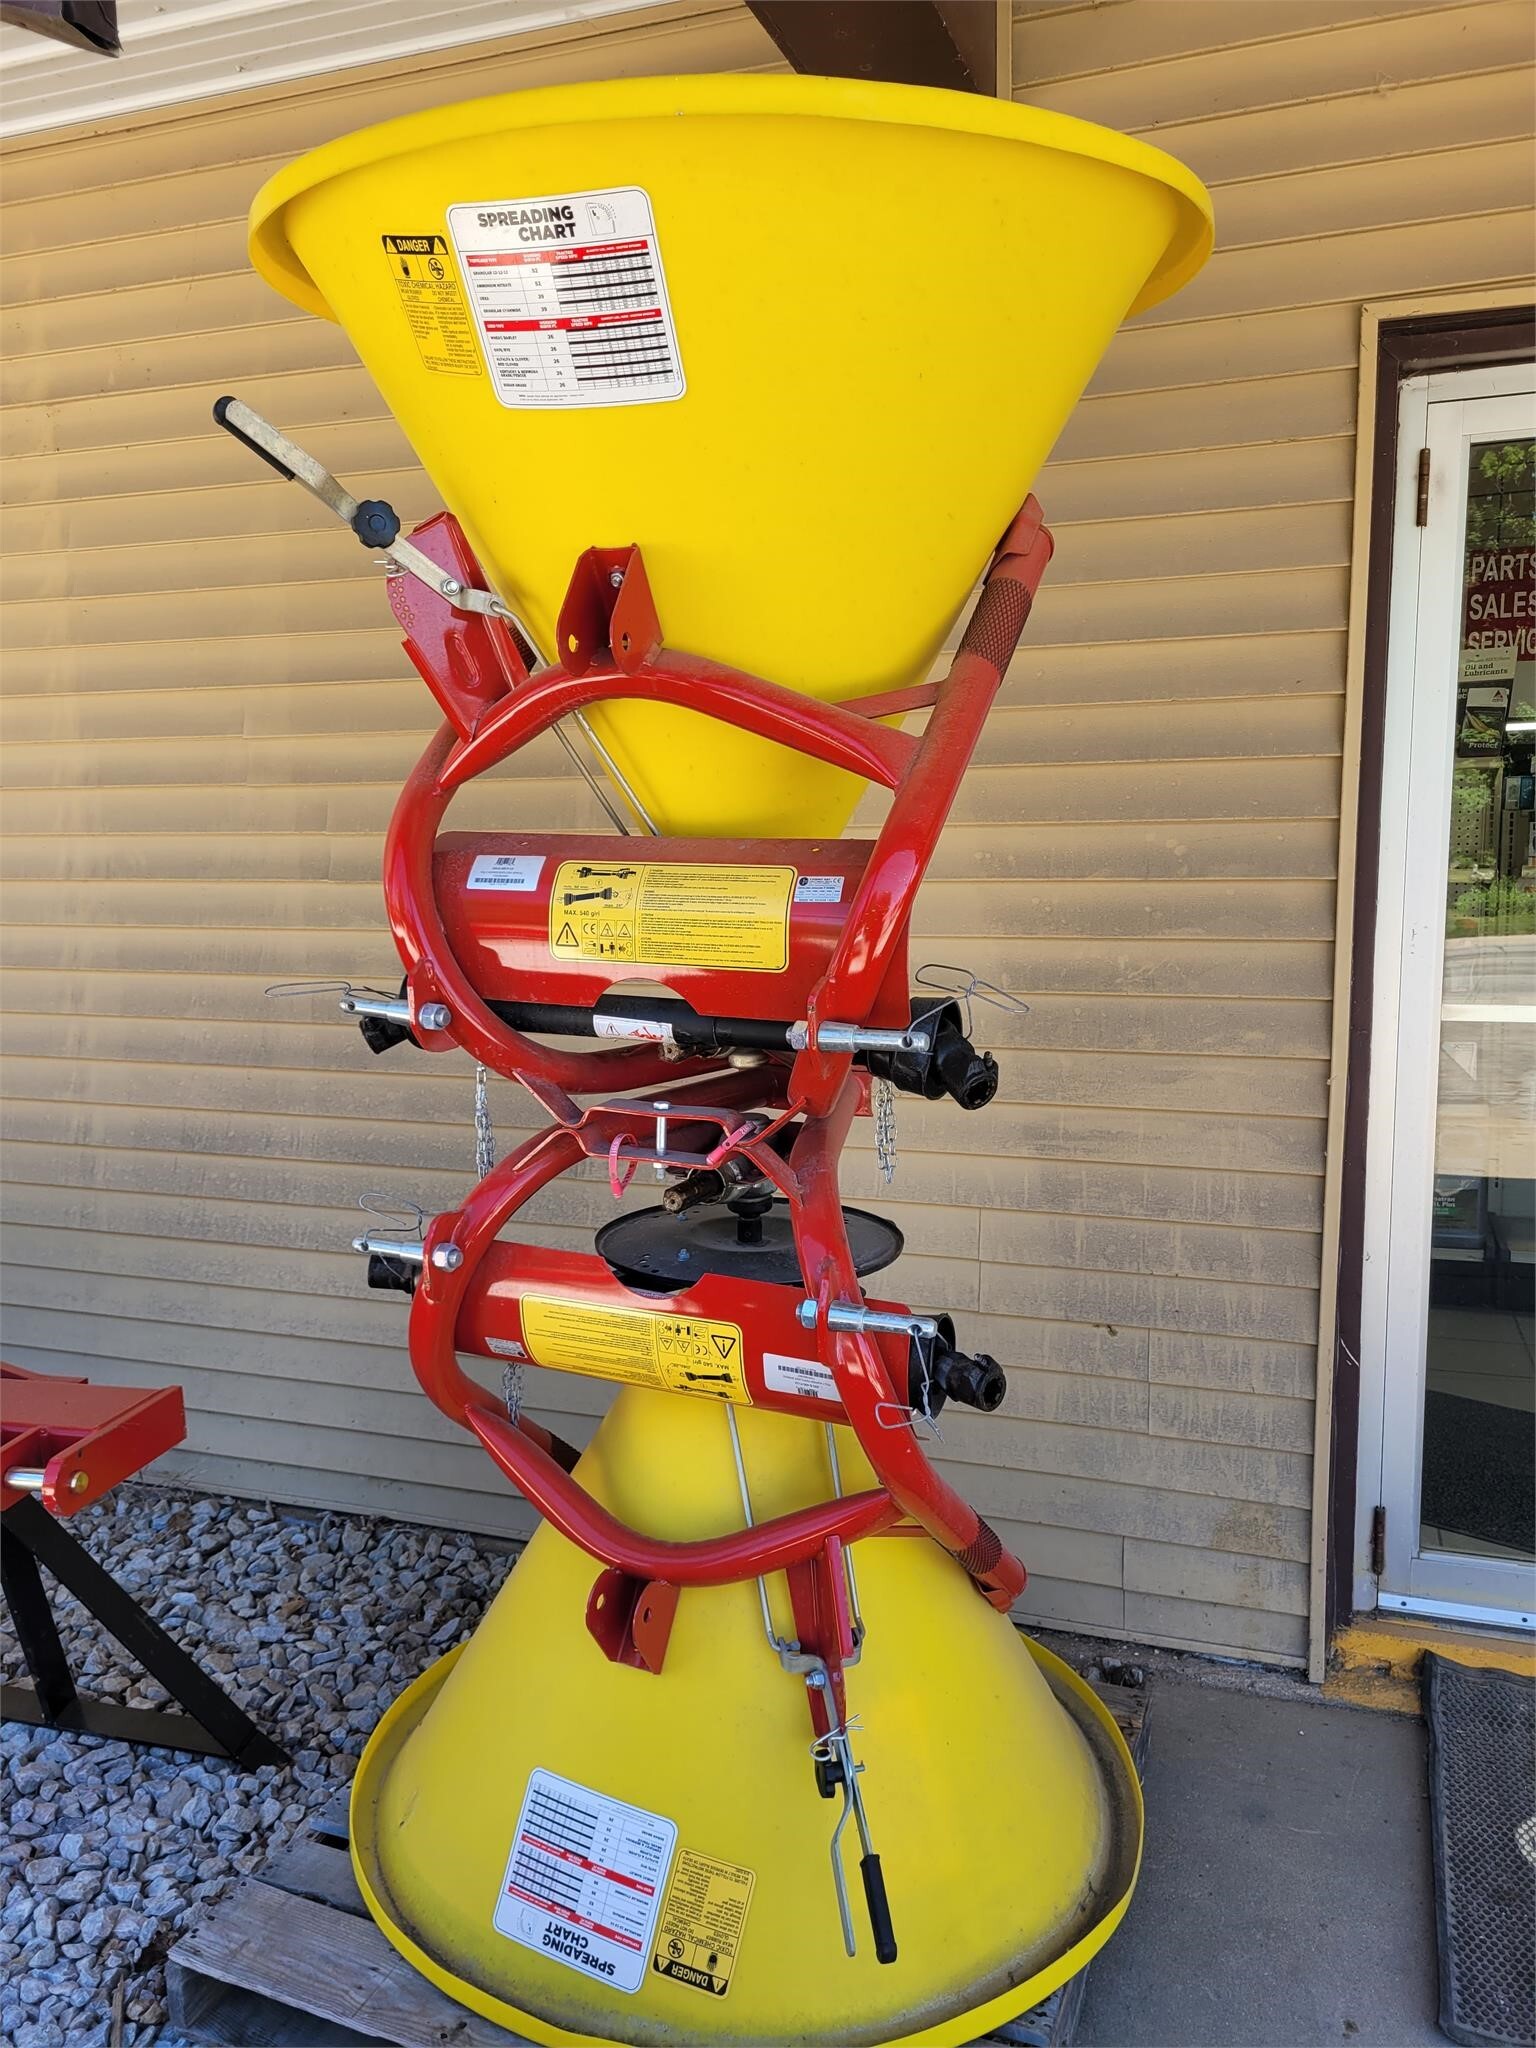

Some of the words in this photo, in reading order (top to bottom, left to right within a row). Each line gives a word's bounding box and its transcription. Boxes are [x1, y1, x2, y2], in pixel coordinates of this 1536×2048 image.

[477, 205, 574, 228] SPREADING
[518, 222, 576, 242] CHART
[396, 239, 431, 252] DANGER
[1471, 554, 1535, 582] PARTS
[1469, 591, 1535, 620] SALES
[1464, 668, 1508, 677] Lubricants
[1468, 741, 1499, 749] Protect
[545, 1921, 589, 1948] CHART
[663, 1925, 687, 1938] HAZARD
[686, 1933, 716, 1949] CHEMICAL
[542, 1935, 616, 1976] SPREADING
[716, 1944, 733, 1955] TOXIC
[671, 1964, 709, 1987] DANGER
